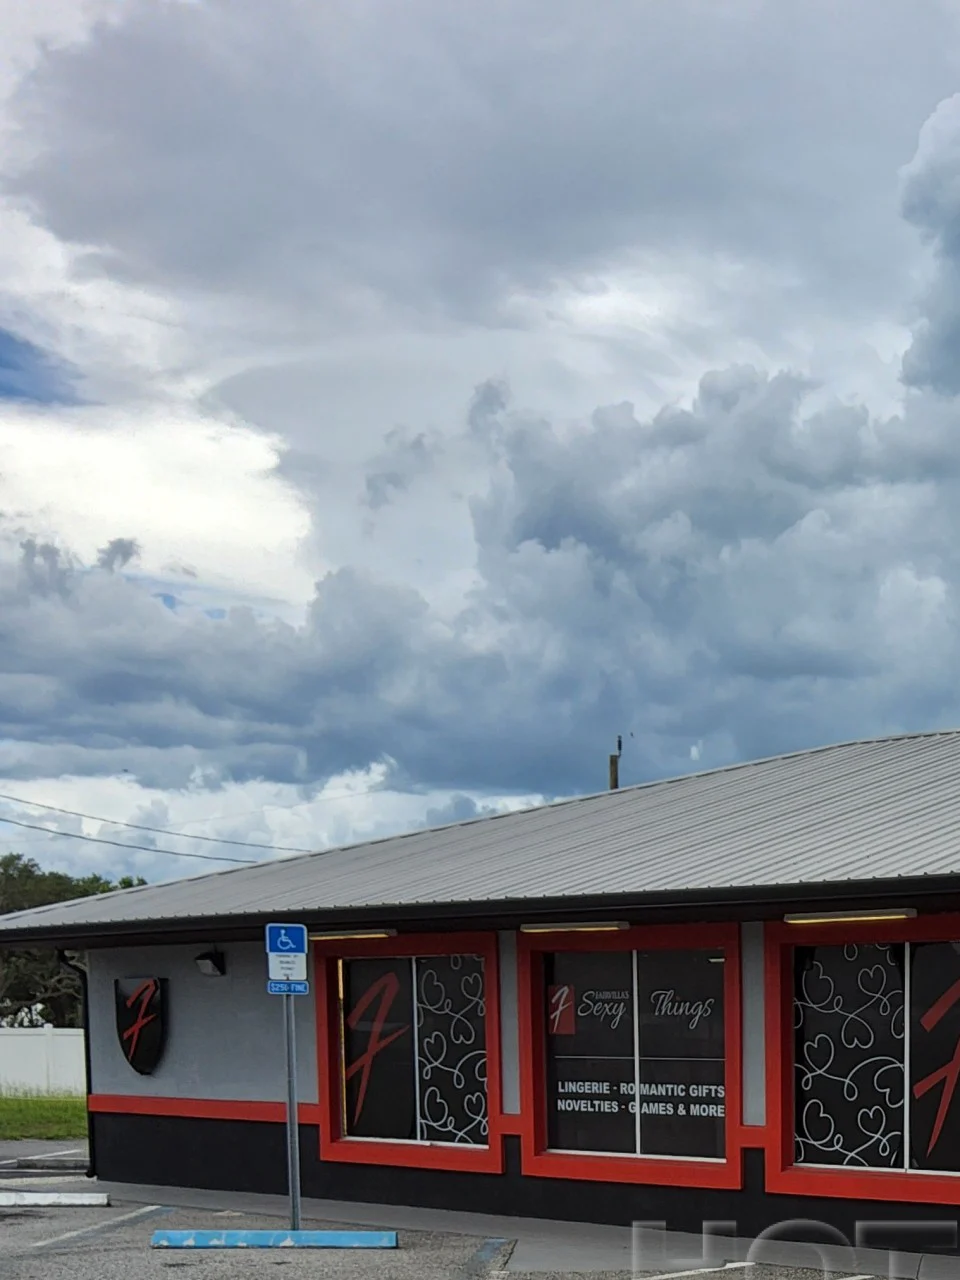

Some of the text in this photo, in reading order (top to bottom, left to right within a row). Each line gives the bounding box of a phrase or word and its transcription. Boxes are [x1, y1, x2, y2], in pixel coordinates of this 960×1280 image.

[577, 989, 715, 1029] Sexy Things
[558, 1081, 611, 1094] LINGERIE
[619, 1082, 686, 1097] ROMANTIC
[689, 1085, 726, 1098] GIFTS
[557, 1099, 619, 1112] NOVELTIES
[628, 1101, 674, 1115] GAMES
[677, 1103, 687, 1116] &
[690, 1104, 726, 1117] MORE
